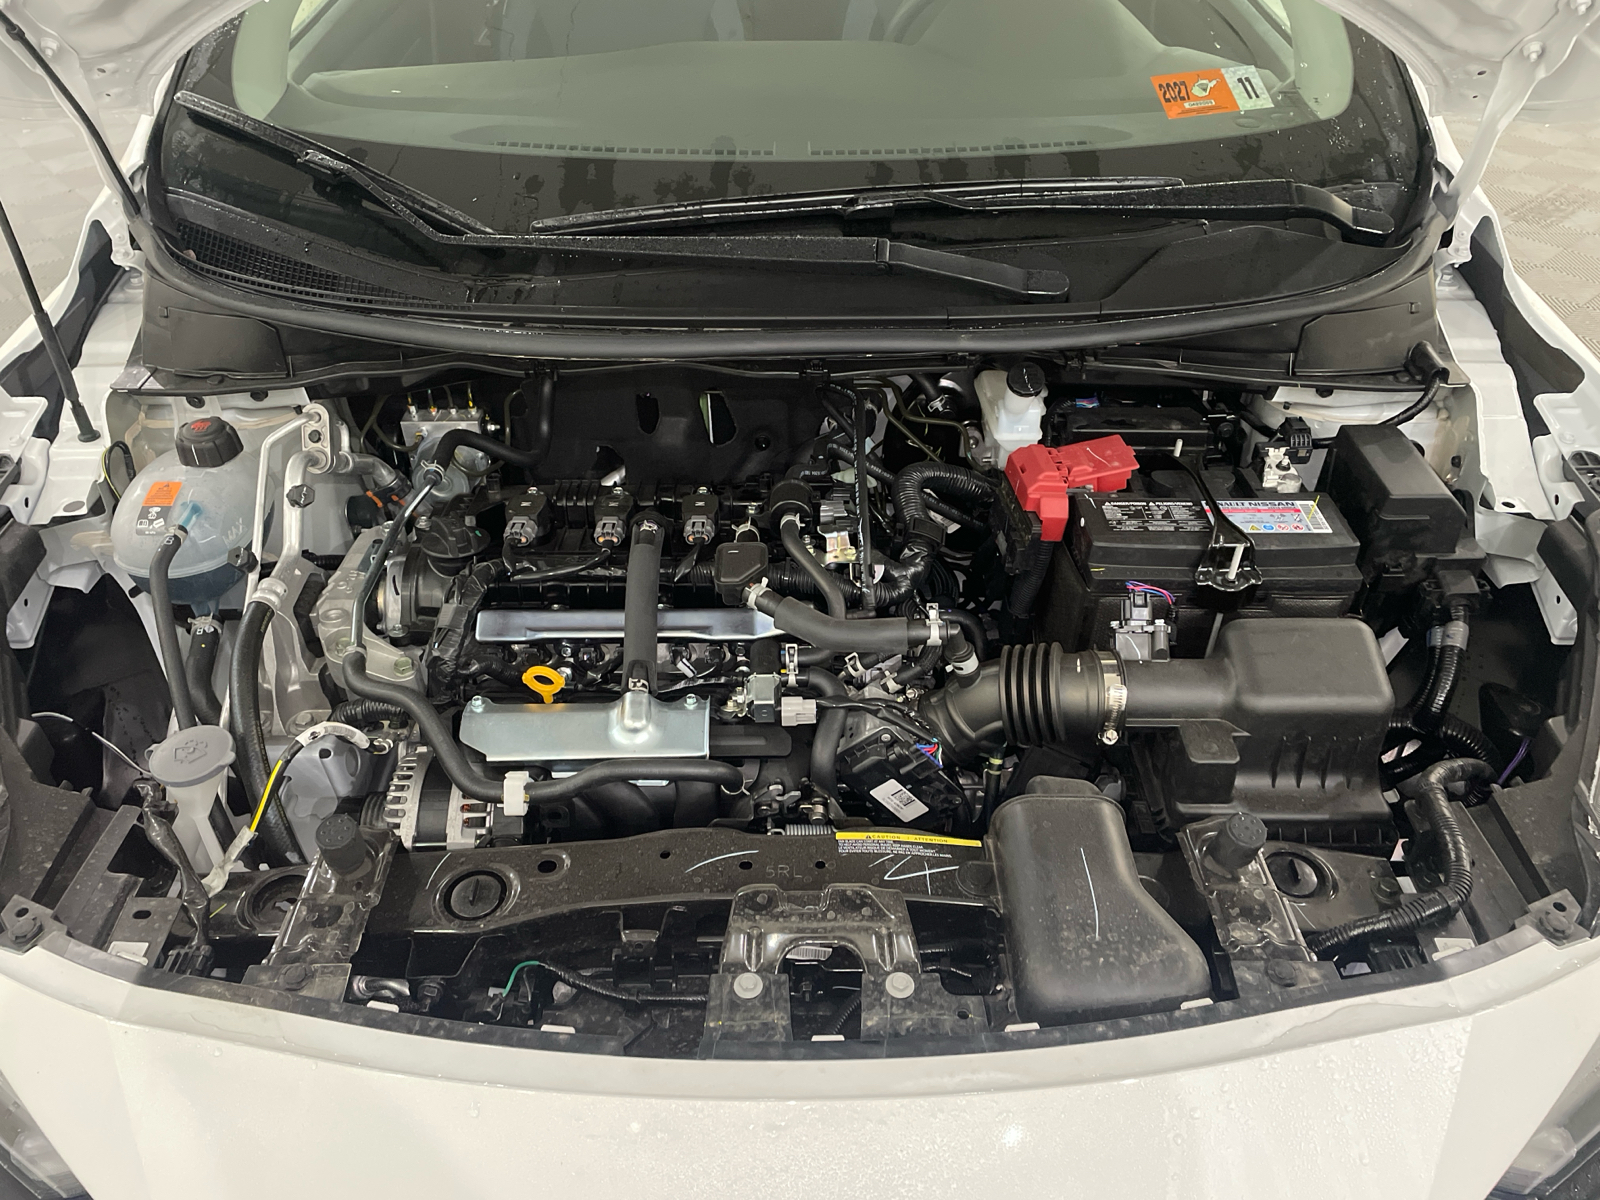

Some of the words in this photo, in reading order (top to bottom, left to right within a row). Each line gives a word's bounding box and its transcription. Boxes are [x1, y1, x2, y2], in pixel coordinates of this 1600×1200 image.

[1158, 80, 1191, 103] 2027
[1237, 76, 1260, 100] 11
[765, 864, 803, 879] 5RL
